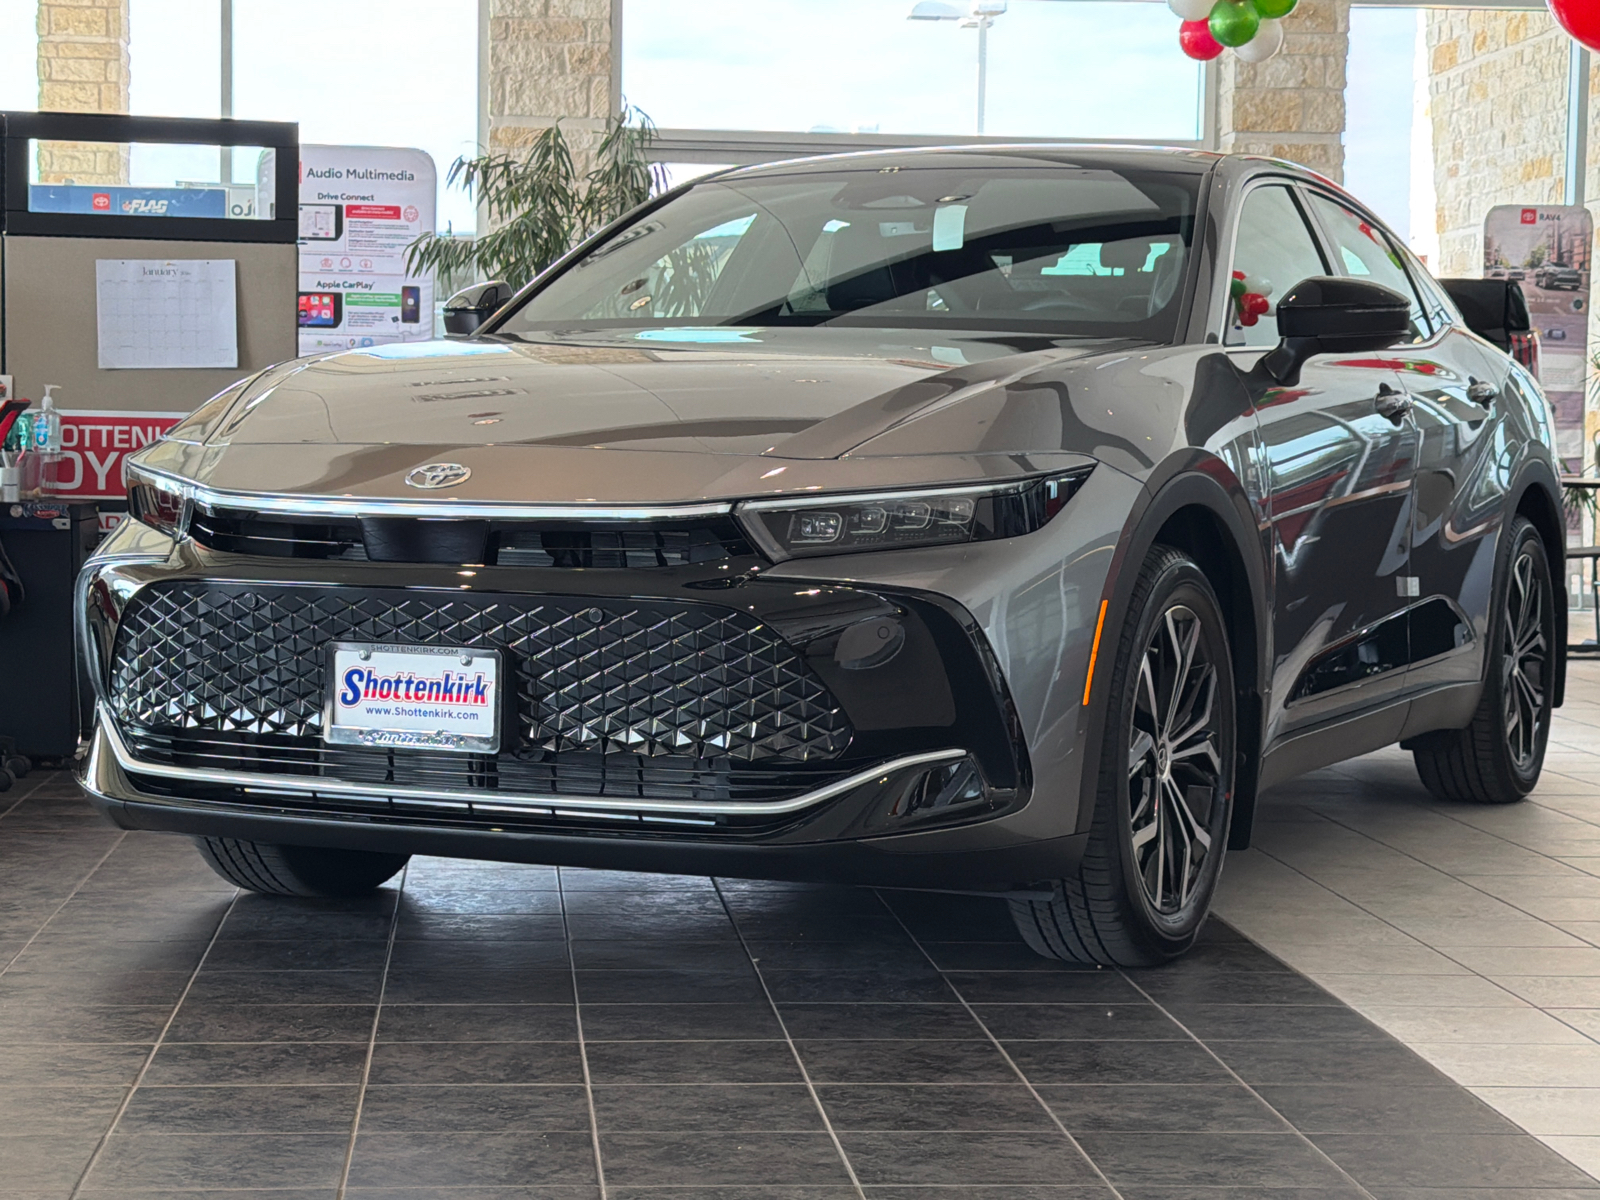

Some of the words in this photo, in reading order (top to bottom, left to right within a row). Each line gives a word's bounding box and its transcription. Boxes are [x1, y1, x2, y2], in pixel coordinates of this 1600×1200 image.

[306, 168, 342, 179] Audio
[346, 169, 414, 181] Multimedia
[317, 192, 339, 200] Drive
[340, 193, 375, 201] Connect
[131, 199, 168, 214] FLAG
[1539, 213, 1561, 221] RAV4
[142, 266, 179, 277] January
[316, 280, 341, 289] Apple
[342, 281, 375, 291] CarPlay
[60, 424, 171, 448] OTTENK
[370, 644, 459, 655] SHOTTENKIRK.COM
[339, 667, 491, 707] Shottenkirk
[365, 706, 479, 721] www.Shottenkirk.com
